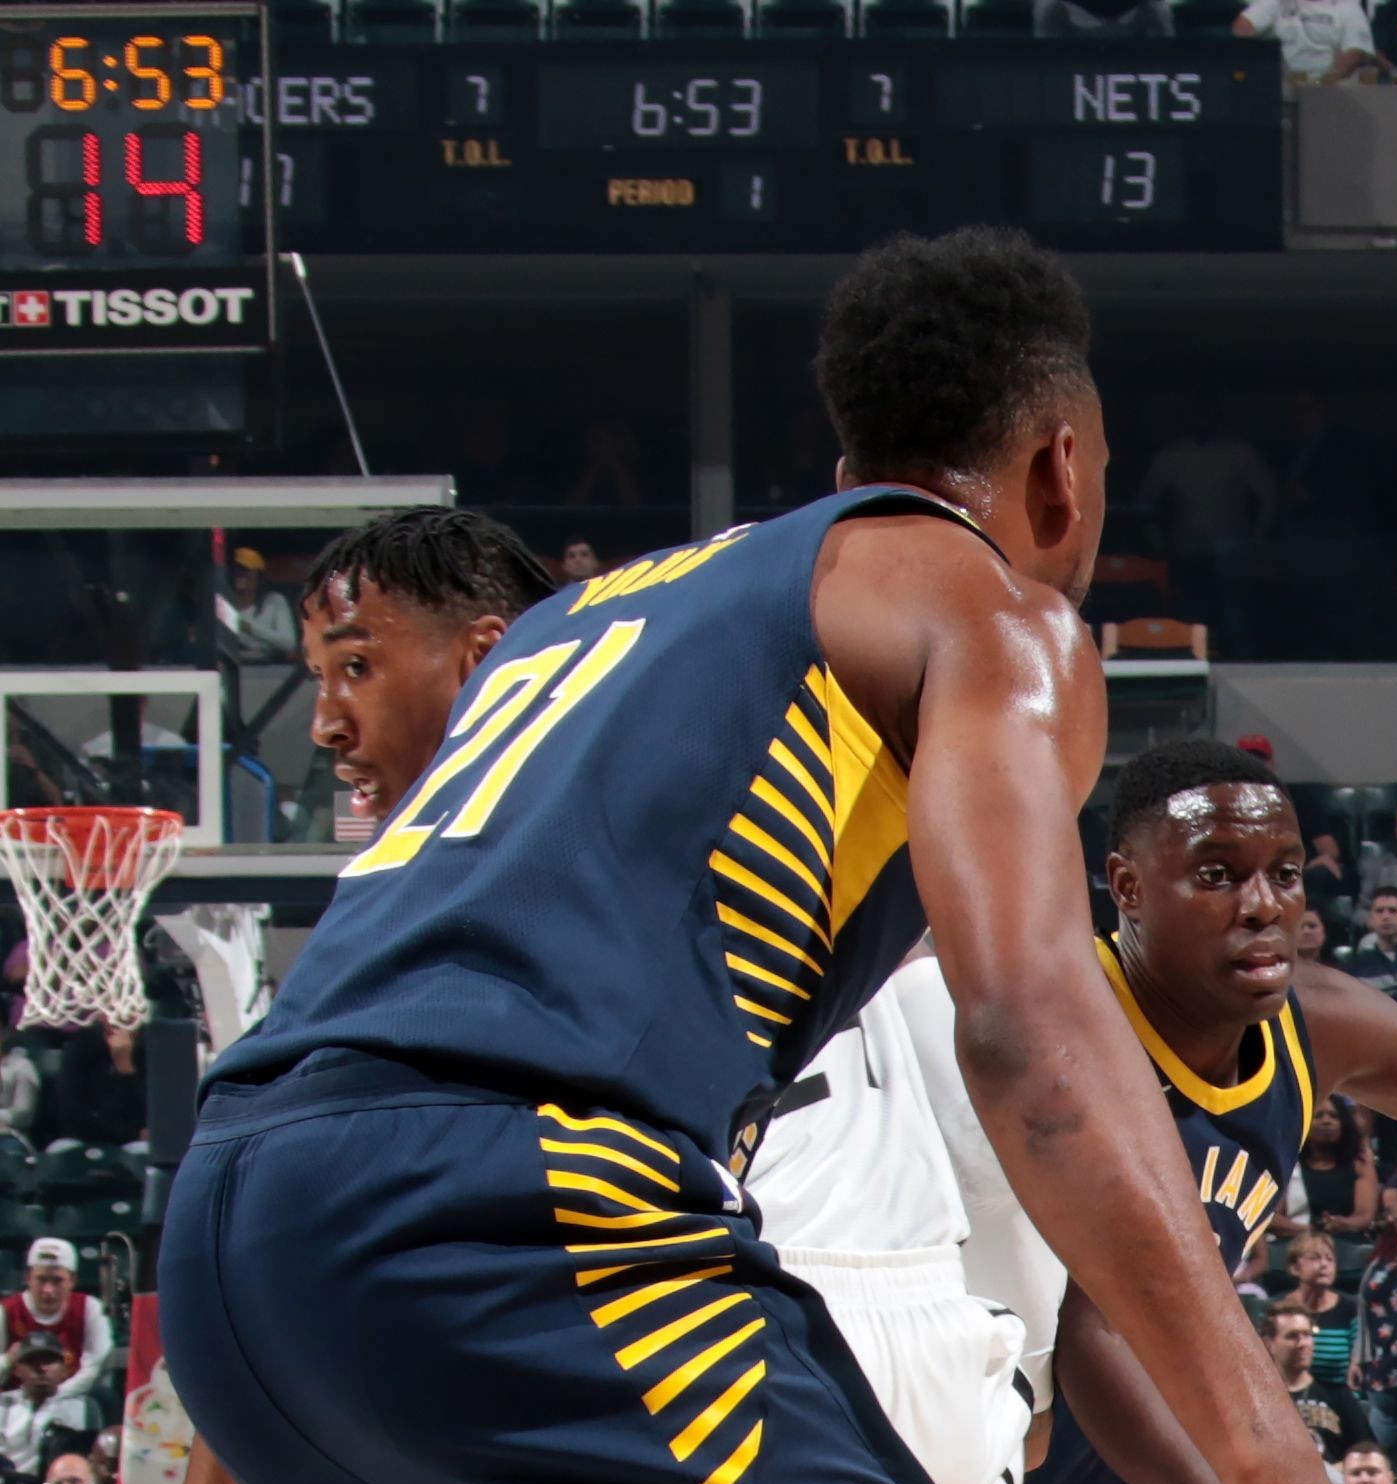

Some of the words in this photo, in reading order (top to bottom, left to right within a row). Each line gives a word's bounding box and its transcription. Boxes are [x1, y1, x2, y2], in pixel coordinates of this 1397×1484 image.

[49, 35, 225, 112] 6:53
[466, 75, 489, 114] 7
[870, 74, 893, 112] 7
[632, 79, 763, 137] 6:53
[1073, 73, 1202, 122] NETS
[441, 139, 512, 166] T.O.L.
[843, 138, 913, 166] T.O.L.
[82, 132, 204, 246] 14
[608, 178, 696, 206] PERIOD
[750, 175, 764, 210] 1
[1101, 151, 1157, 208] 13
[53, 288, 256, 327] TISSOT
[338, 617, 648, 880] 21
